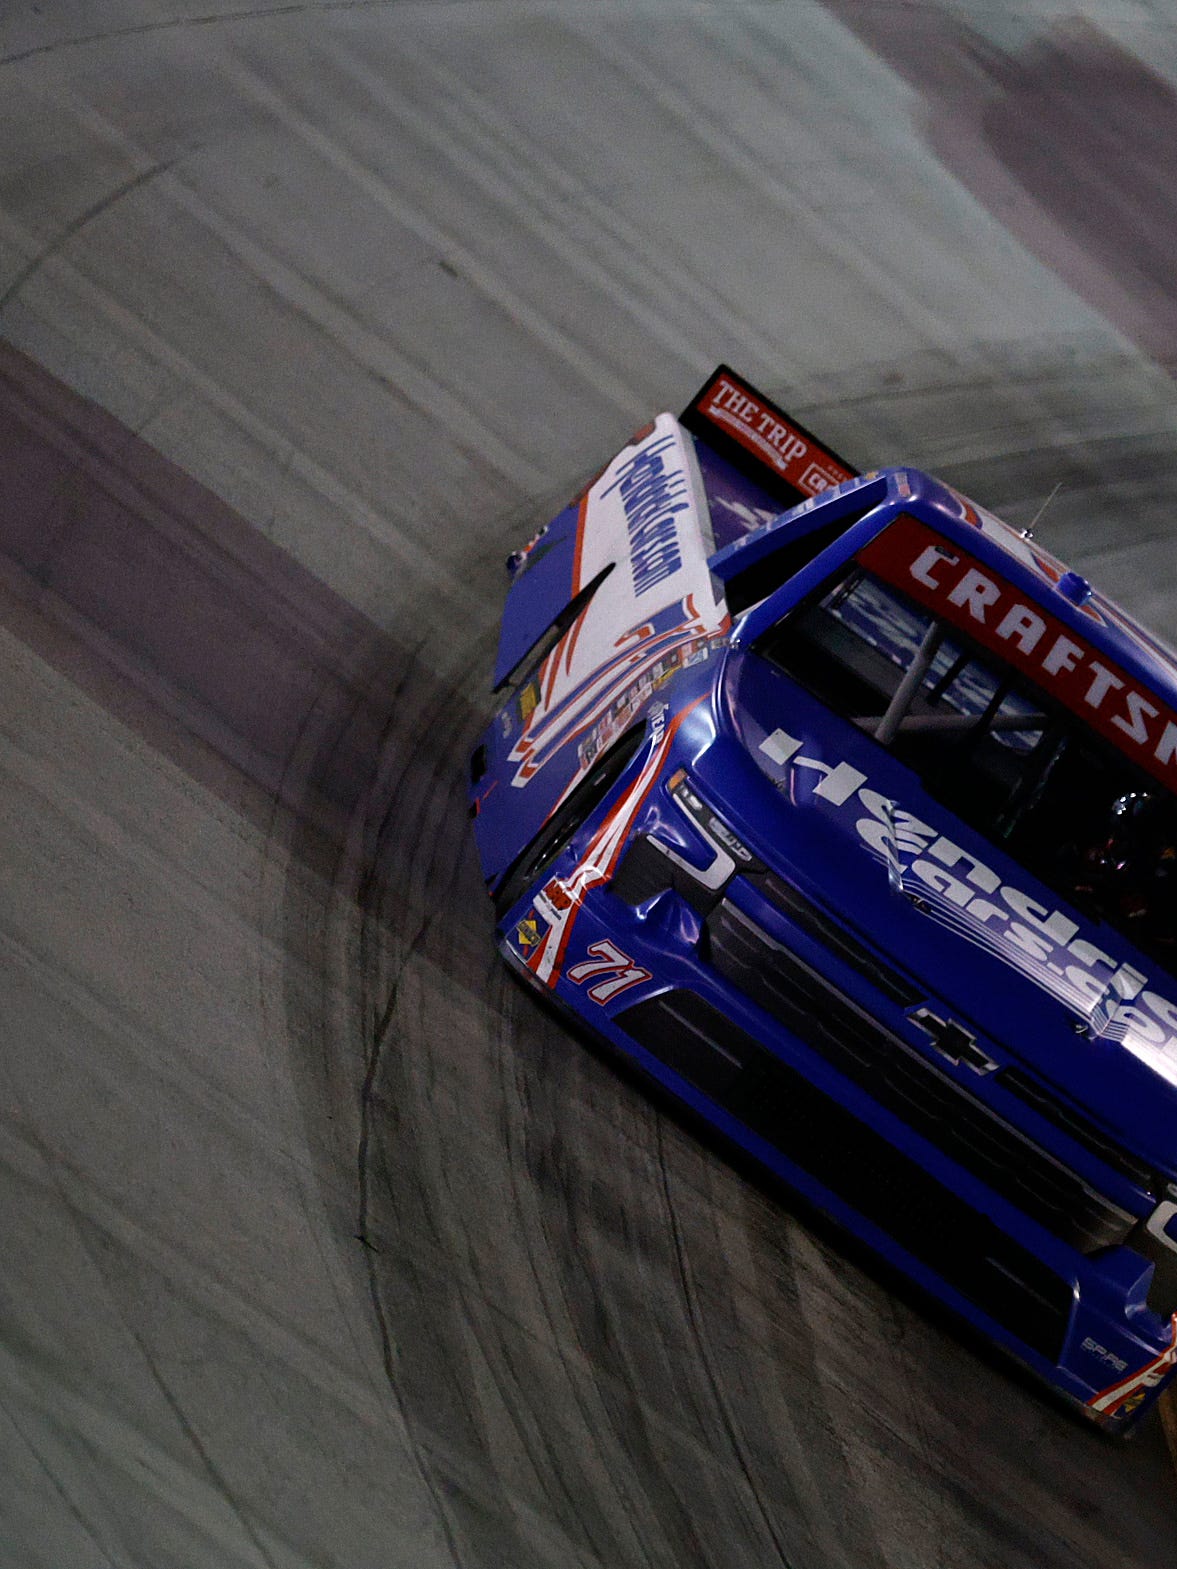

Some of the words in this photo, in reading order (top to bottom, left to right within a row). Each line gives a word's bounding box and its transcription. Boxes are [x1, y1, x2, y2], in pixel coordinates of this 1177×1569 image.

[711, 379, 760, 422] THE
[756, 412, 808, 462] TRIP
[566, 938, 654, 1007] 71
